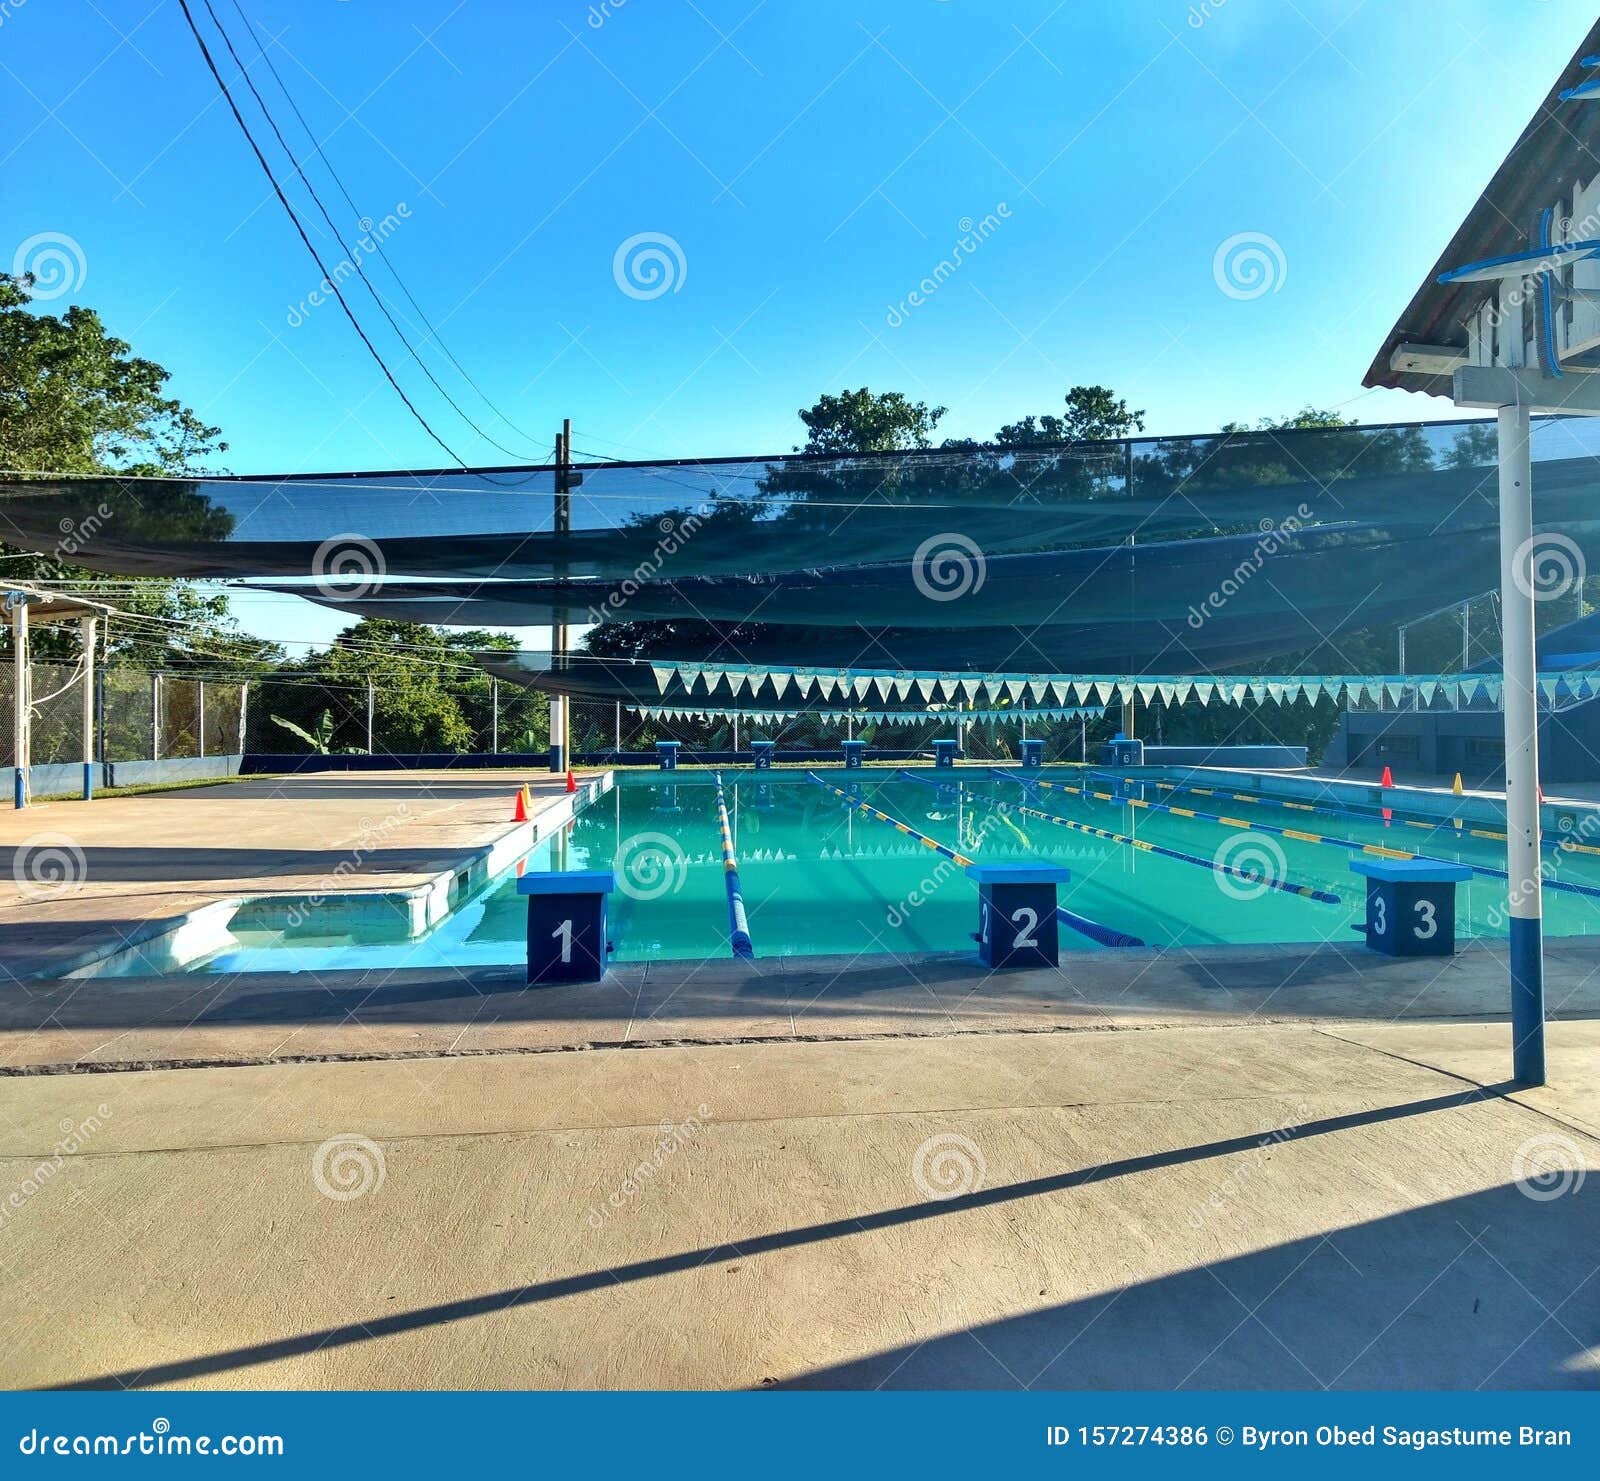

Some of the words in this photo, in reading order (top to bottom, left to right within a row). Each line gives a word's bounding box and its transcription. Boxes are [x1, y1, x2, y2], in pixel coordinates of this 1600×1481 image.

[664, 758, 669, 768] 1
[759, 758, 767, 767] 2
[851, 757, 858, 766] 3
[943, 756, 950, 764] 4
[1031, 756, 1037, 766] 5
[1123, 755, 1130, 764] 6
[1374, 896, 1386, 935] 3
[1413, 900, 1437, 939] 3
[1012, 907, 1038, 949] 2
[552, 920, 572, 962] 1
